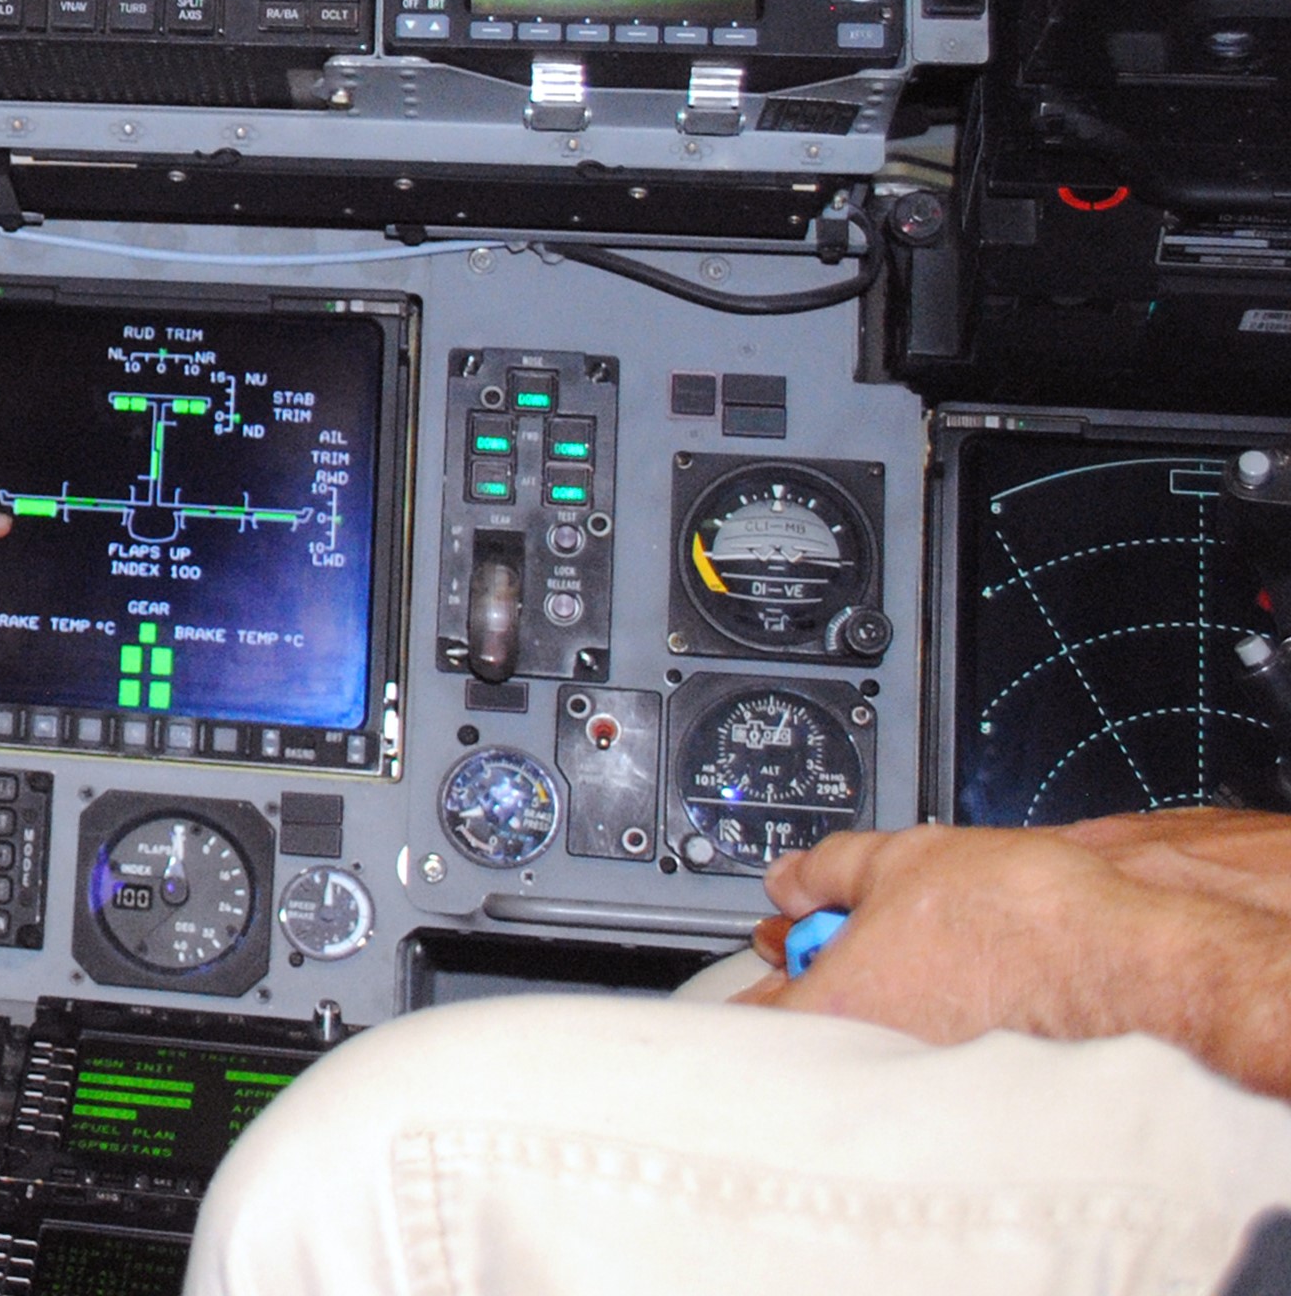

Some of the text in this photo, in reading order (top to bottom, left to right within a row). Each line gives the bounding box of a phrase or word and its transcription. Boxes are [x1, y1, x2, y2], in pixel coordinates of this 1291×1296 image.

[120, 3, 147, 13] TURB
[266, 8, 298, 19] RA/BA
[321, 10, 349, 20] DCLT
[179, 10, 202, 21] AXIS
[123, 326, 203, 342] RUD TRIM
[108, 347, 127, 361] NL
[195, 351, 216, 364] NR
[124, 361, 141, 373] 10
[184, 364, 200, 376] 10
[245, 372, 267, 386] NU
[273, 391, 315, 406] STAB
[517, 394, 550, 407] DOWN
[273, 408, 312, 423] TRIM
[242, 425, 265, 438] ND
[319, 430, 348, 445] AIL
[476, 436, 509, 451] DOWN
[553, 442, 587, 456] DOWN
[311, 450, 350, 466] TRIM
[316, 470, 349, 485] RWD
[552, 486, 584, 500] DOWN
[558, 512, 577, 522] TEST
[108, 542, 192, 561] FLAPS UP
[312, 553, 345, 568] LWD
[111, 561, 201, 579] INDEX 100
[547, 579, 581, 589] RELEASE
[128, 600, 170, 616] GEAR
[51, 617, 91, 633] TEMP
[174, 625, 226, 643] BRAKE
[238, 630, 279, 646] TEMP
[760, 765, 780, 775] ALT
[776, 823, 791, 833] 60
[138, 843, 172, 855] FLAPS
[738, 844, 757, 853] IAS
[22, 828, 35, 888] MODE
[121, 864, 152, 875] INDEX
[116, 888, 150, 908] 100
[288, 899, 316, 910] SPEED
[175, 922, 196, 933] DEG
[132, 1127, 177, 1141] PLAN
